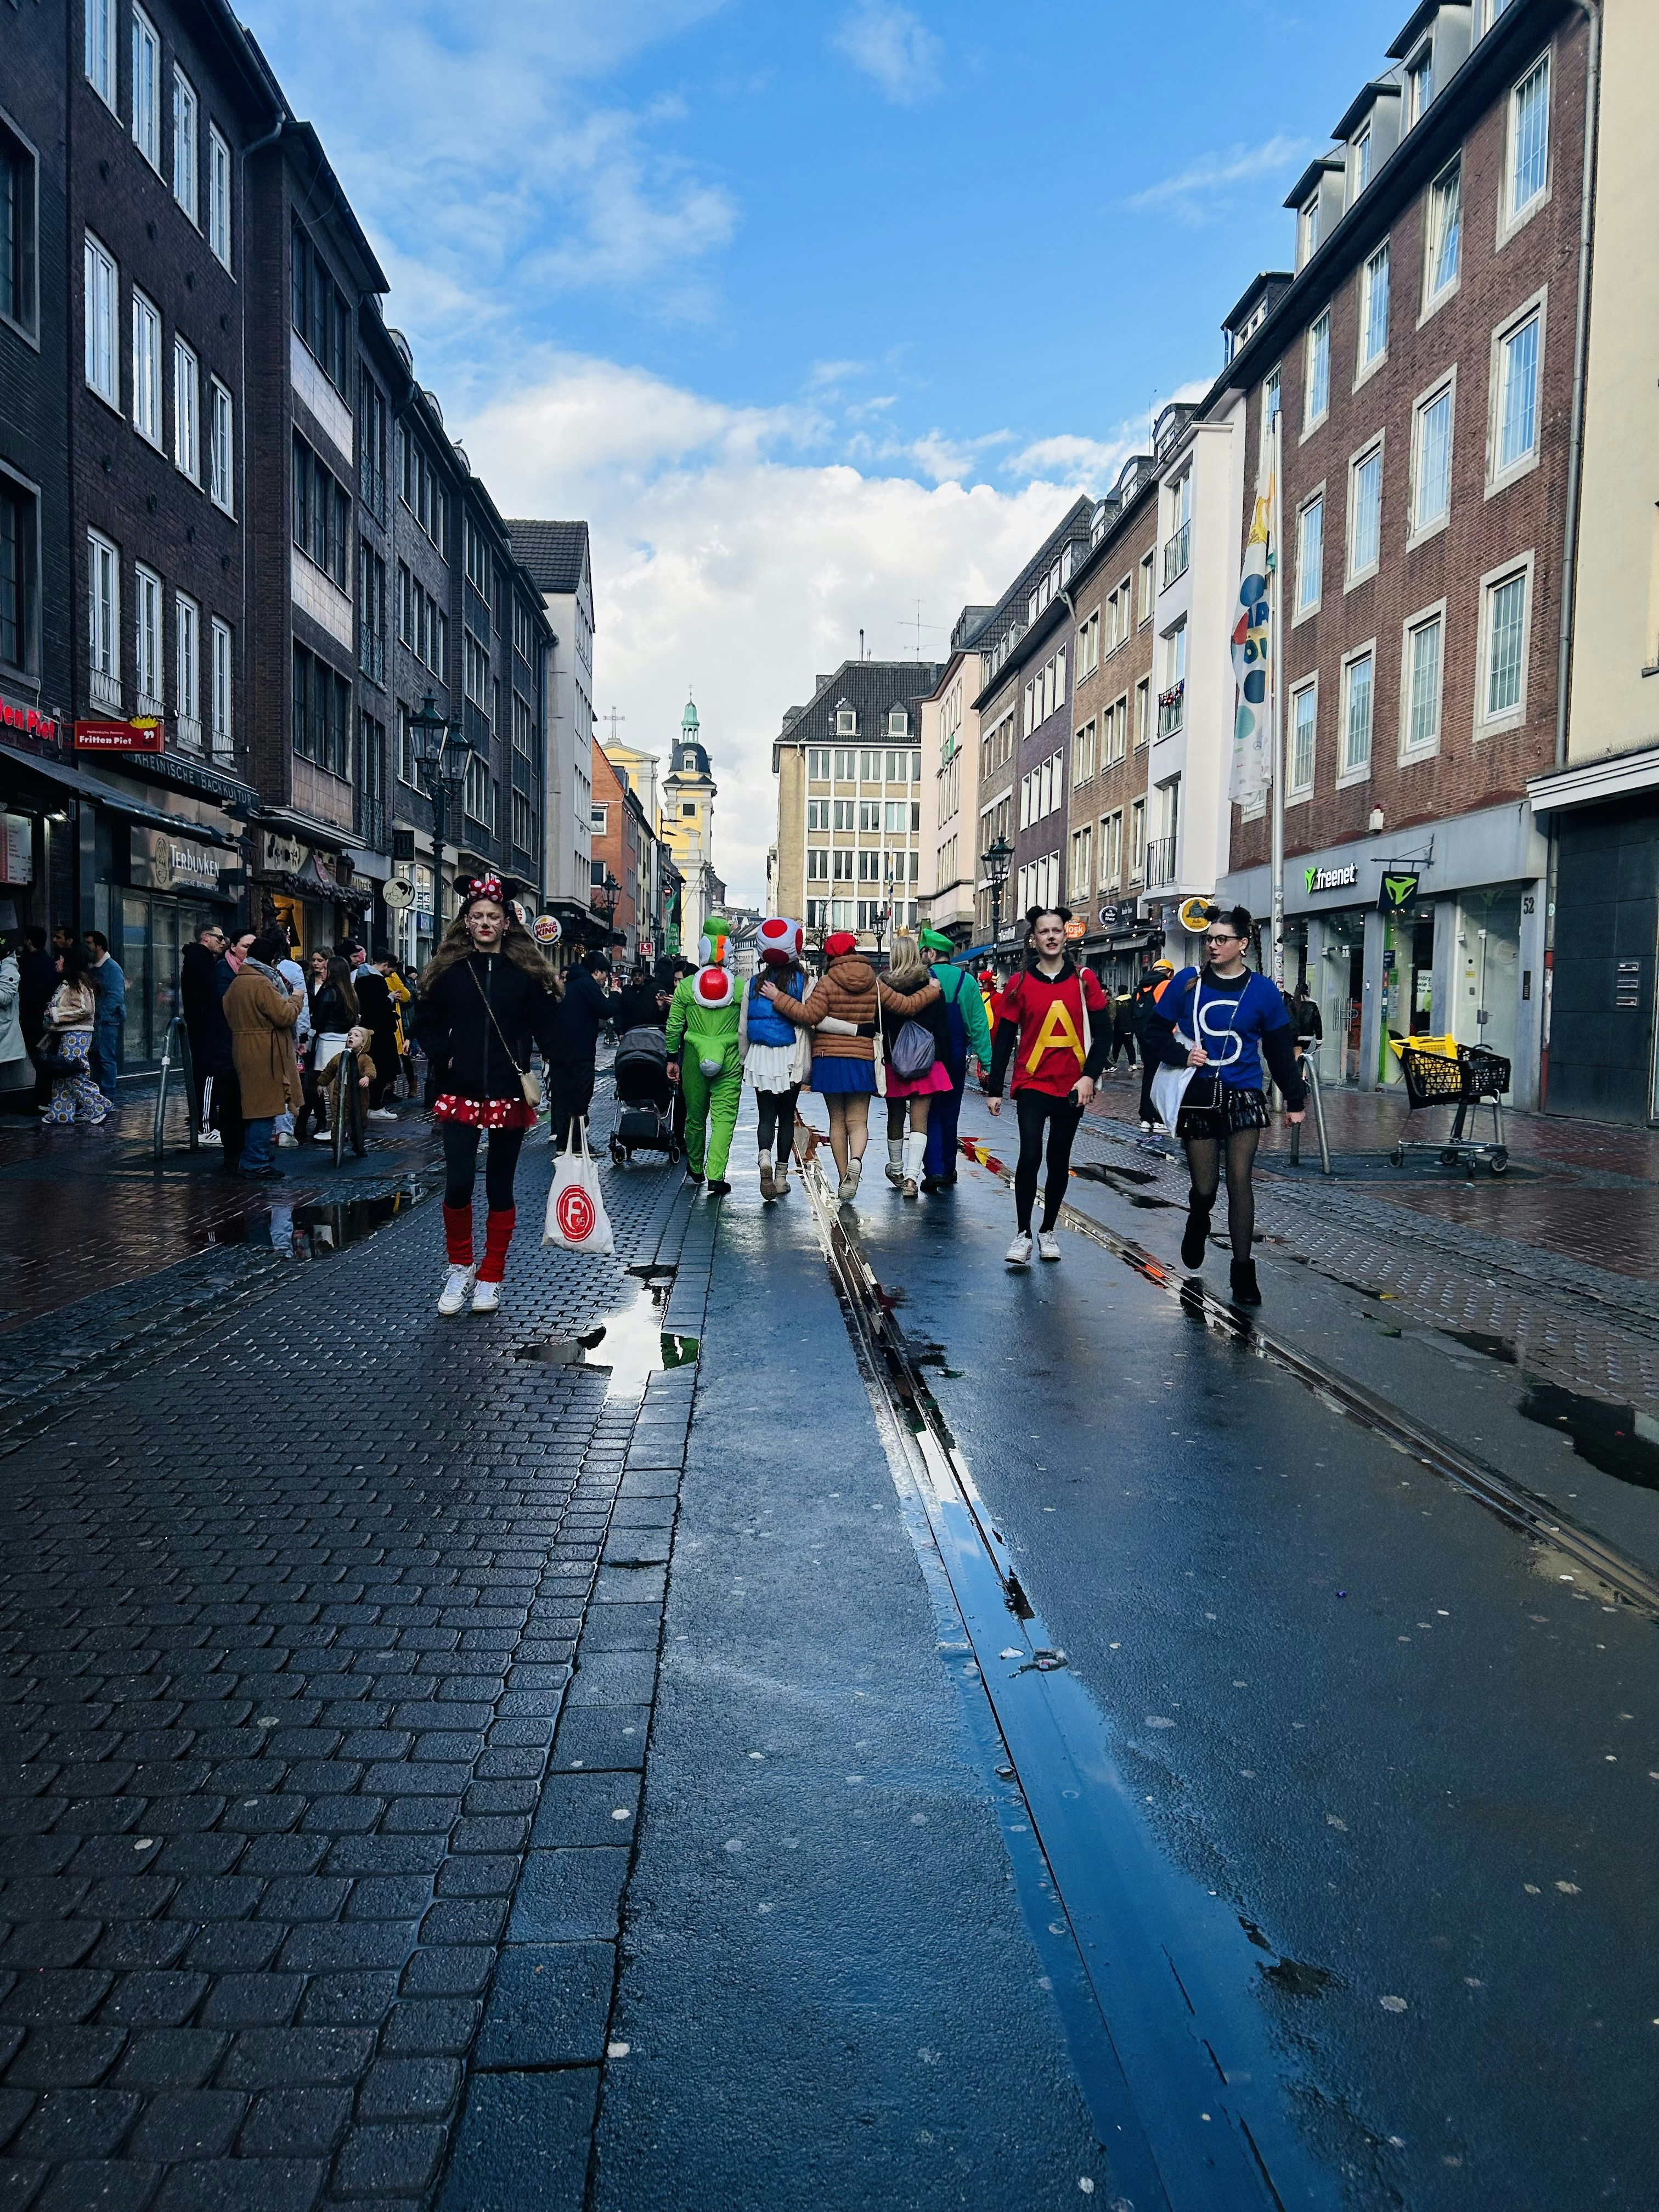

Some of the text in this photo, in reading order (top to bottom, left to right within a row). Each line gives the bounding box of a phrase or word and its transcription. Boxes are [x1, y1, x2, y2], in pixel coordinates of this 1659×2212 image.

[26, 708, 55, 741] Piet
[79, 735, 112, 743] Fritten
[134, 754, 252, 806] RHEINISCHE BACKKULTUR
[1317, 862, 1355, 889] freenet
[1523, 897, 1534, 915] 52
[535, 921, 557, 931] BURGER
[535, 926, 558, 938] KING
[1065, 923, 1084, 934] iosk
[1025, 1000, 1086, 1075] A
[1200, 1000, 1243, 1066] S
